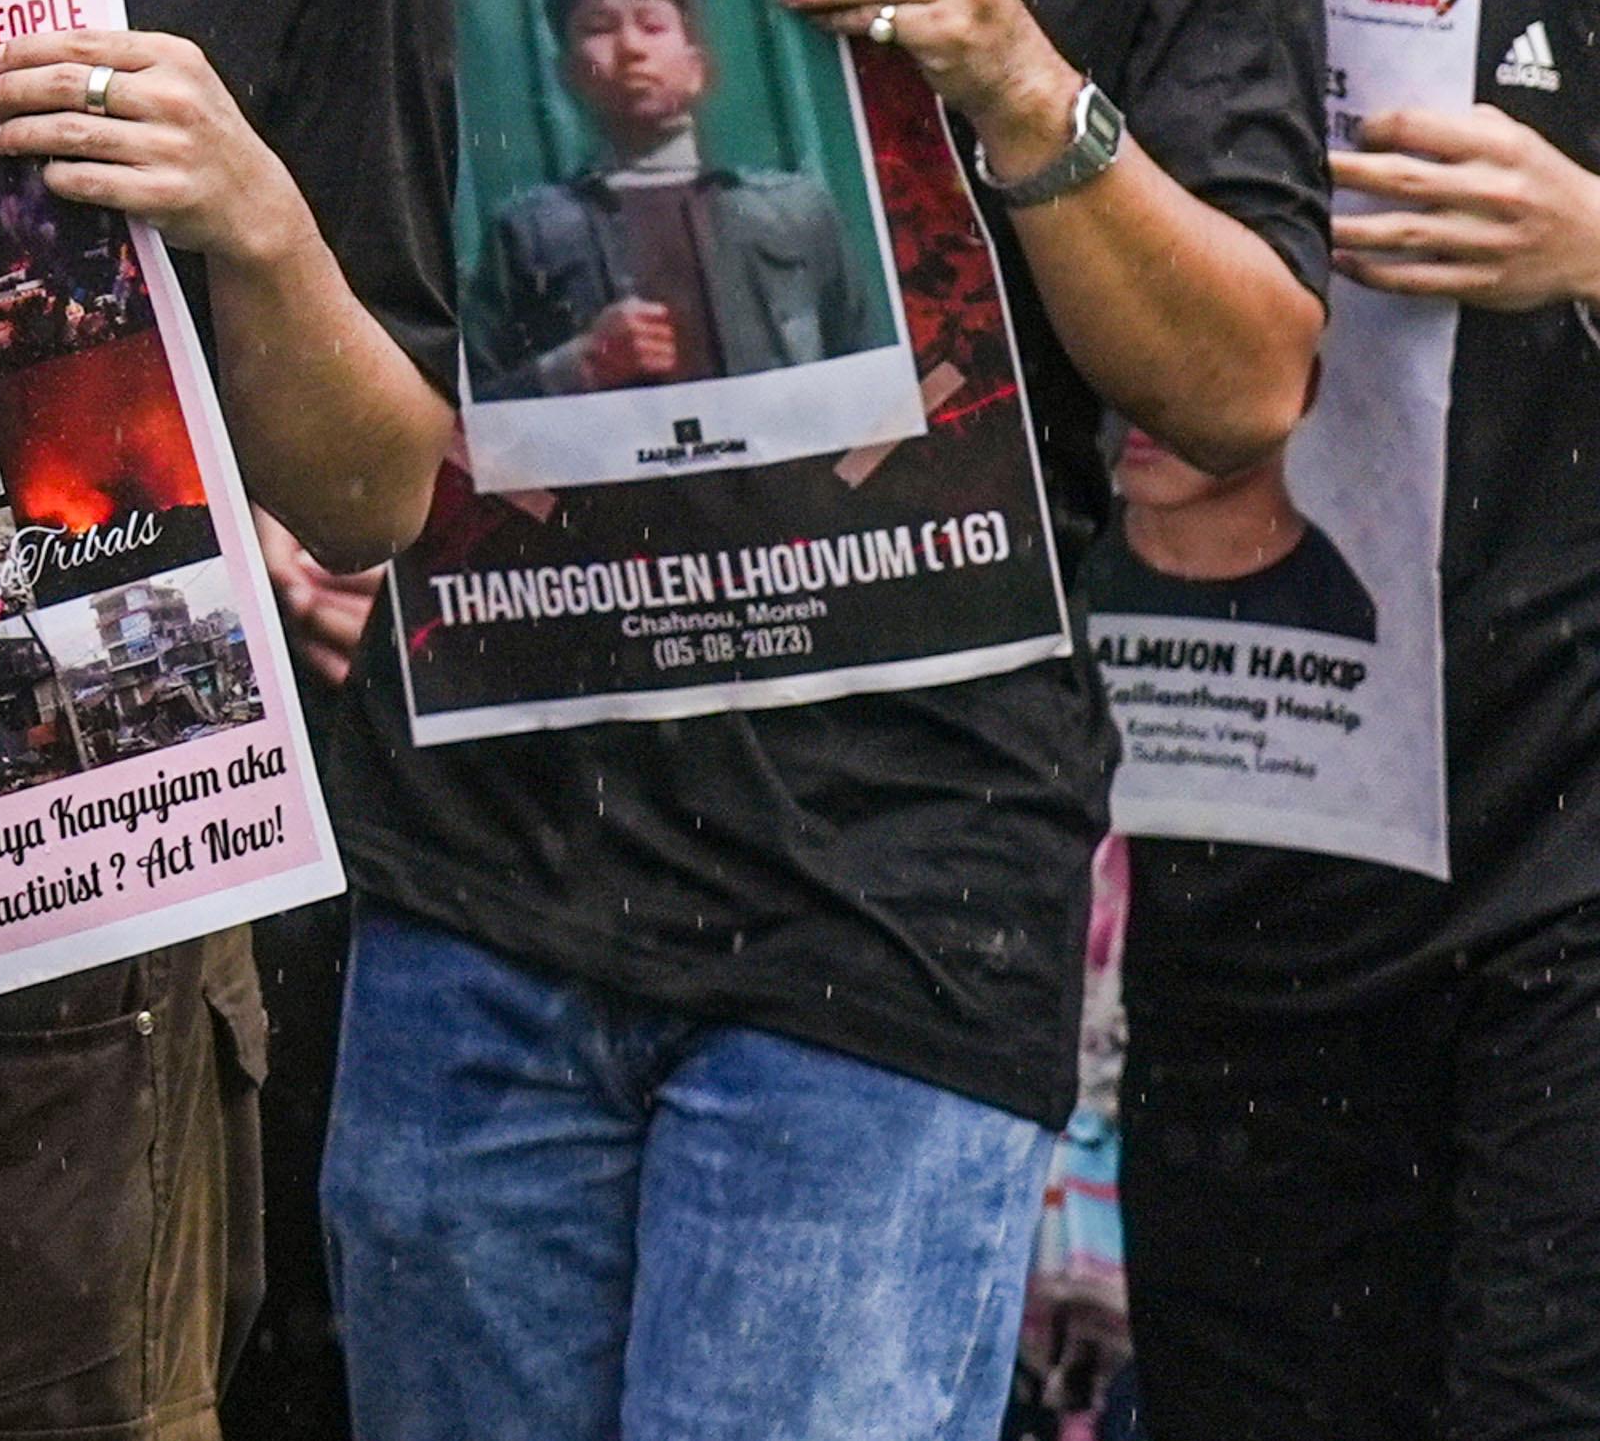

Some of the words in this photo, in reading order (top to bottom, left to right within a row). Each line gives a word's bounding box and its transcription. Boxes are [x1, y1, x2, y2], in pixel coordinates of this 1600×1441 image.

[428, 553, 716, 627] THANGGOULEN
[718, 525, 918, 602] LHOUVUM
[919, 510, 1010, 572] (16)
[746, 596, 828, 625] Moreh
[653, 623, 813, 671] (05-08-2023)
[1098, 634, 1236, 676] ALMUON
[1249, 643, 1367, 691] HAOKIP
[49, 770, 222, 839] Kangujam
[228, 744, 286, 789] aka
[137, 835, 195, 889] Act
[201, 804, 285, 864] Now!
